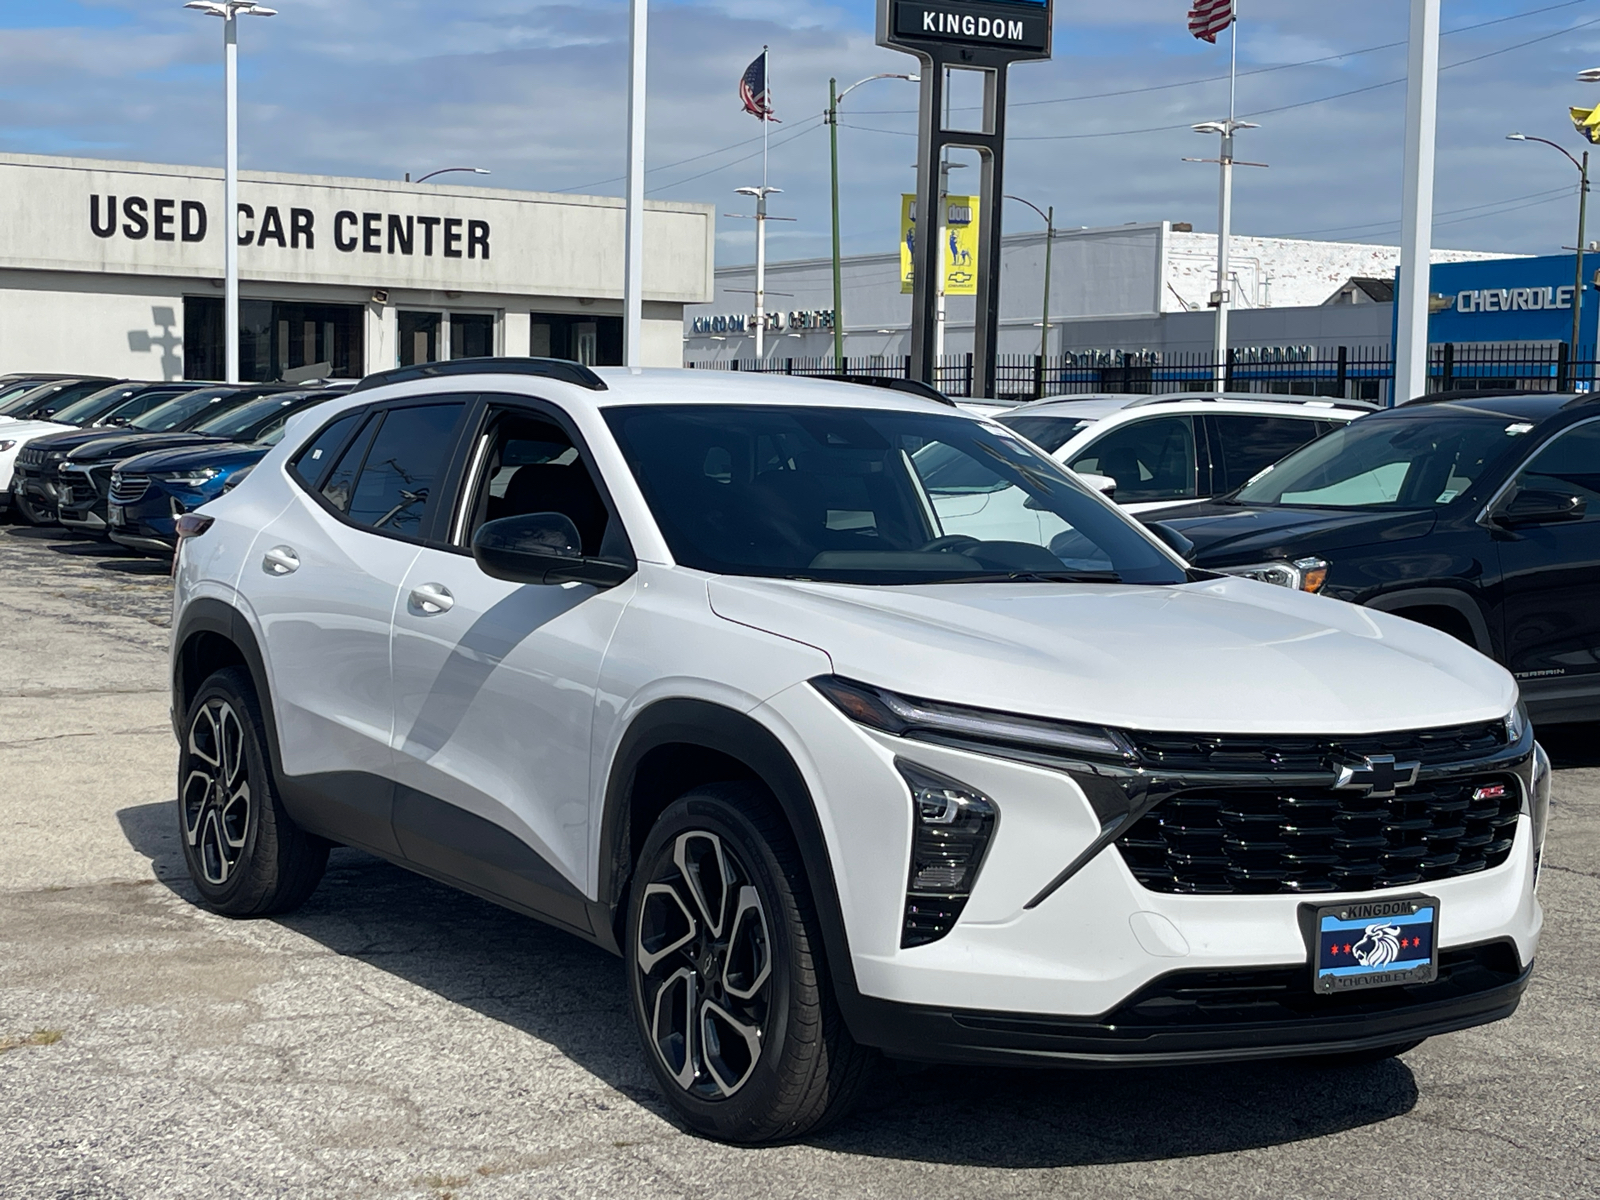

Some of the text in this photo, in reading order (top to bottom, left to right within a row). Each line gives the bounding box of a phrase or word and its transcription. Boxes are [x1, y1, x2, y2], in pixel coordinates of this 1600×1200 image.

[922, 11, 1024, 41] KINGDOM
[89, 194, 491, 260] USED CAR CENTER
[694, 314, 748, 333] KINGDOM
[1514, 668, 1565, 678] TERRAIN
[1473, 785, 1506, 800] RS
[1348, 902, 1411, 918] KINGDOM
